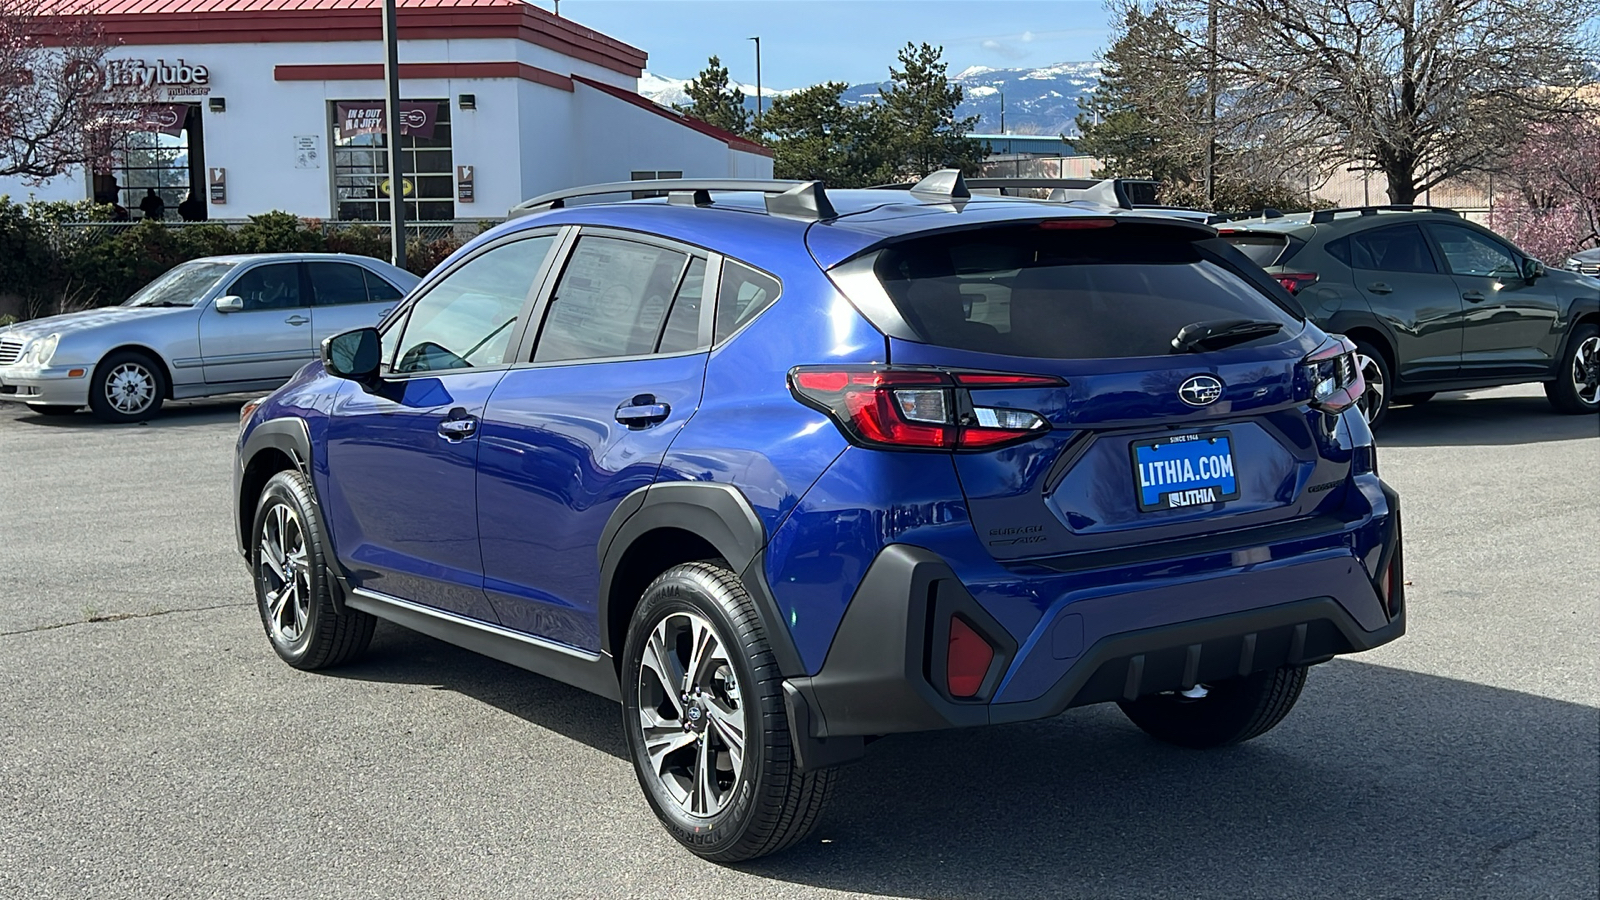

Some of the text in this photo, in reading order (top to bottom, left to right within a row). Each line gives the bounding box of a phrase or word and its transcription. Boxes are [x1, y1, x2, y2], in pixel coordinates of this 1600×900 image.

[168, 86, 209, 96] multicare
[347, 109, 382, 119] IN & OUT
[345, 118, 382, 131] IN A JIFFY
[1138, 454, 1235, 488] LITHIA.COM
[1180, 488, 1216, 507] LITHIA
[989, 524, 1043, 536] SUBARU
